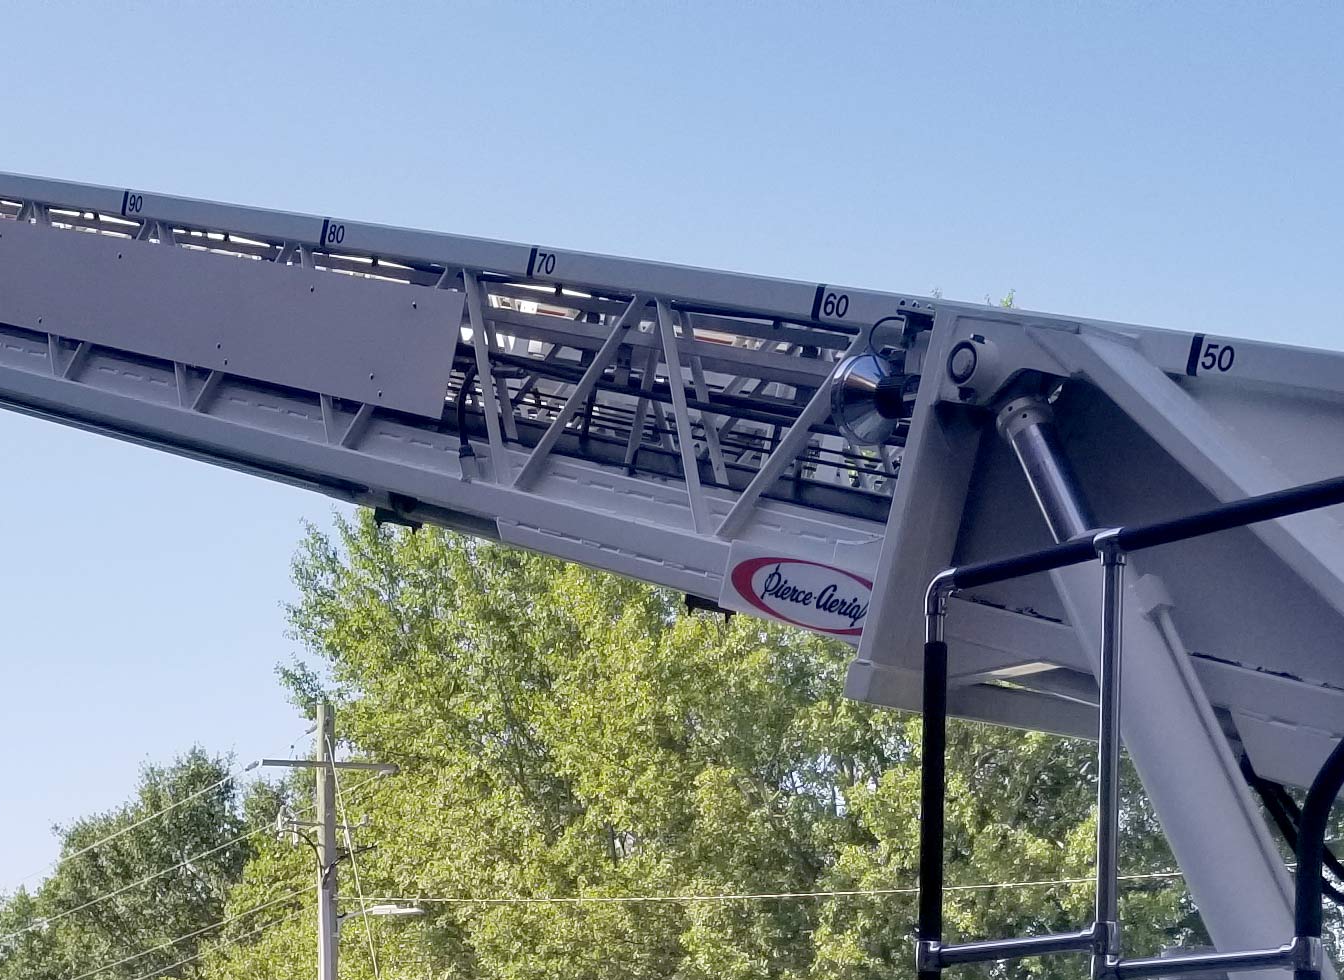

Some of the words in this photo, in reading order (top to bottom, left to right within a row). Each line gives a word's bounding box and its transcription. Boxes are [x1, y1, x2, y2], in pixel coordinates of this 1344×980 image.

[128, 194, 143, 213] 90
[328, 224, 345, 244] 80
[537, 252, 556, 274] 70
[823, 293, 849, 318] 60
[1201, 343, 1235, 372] 50
